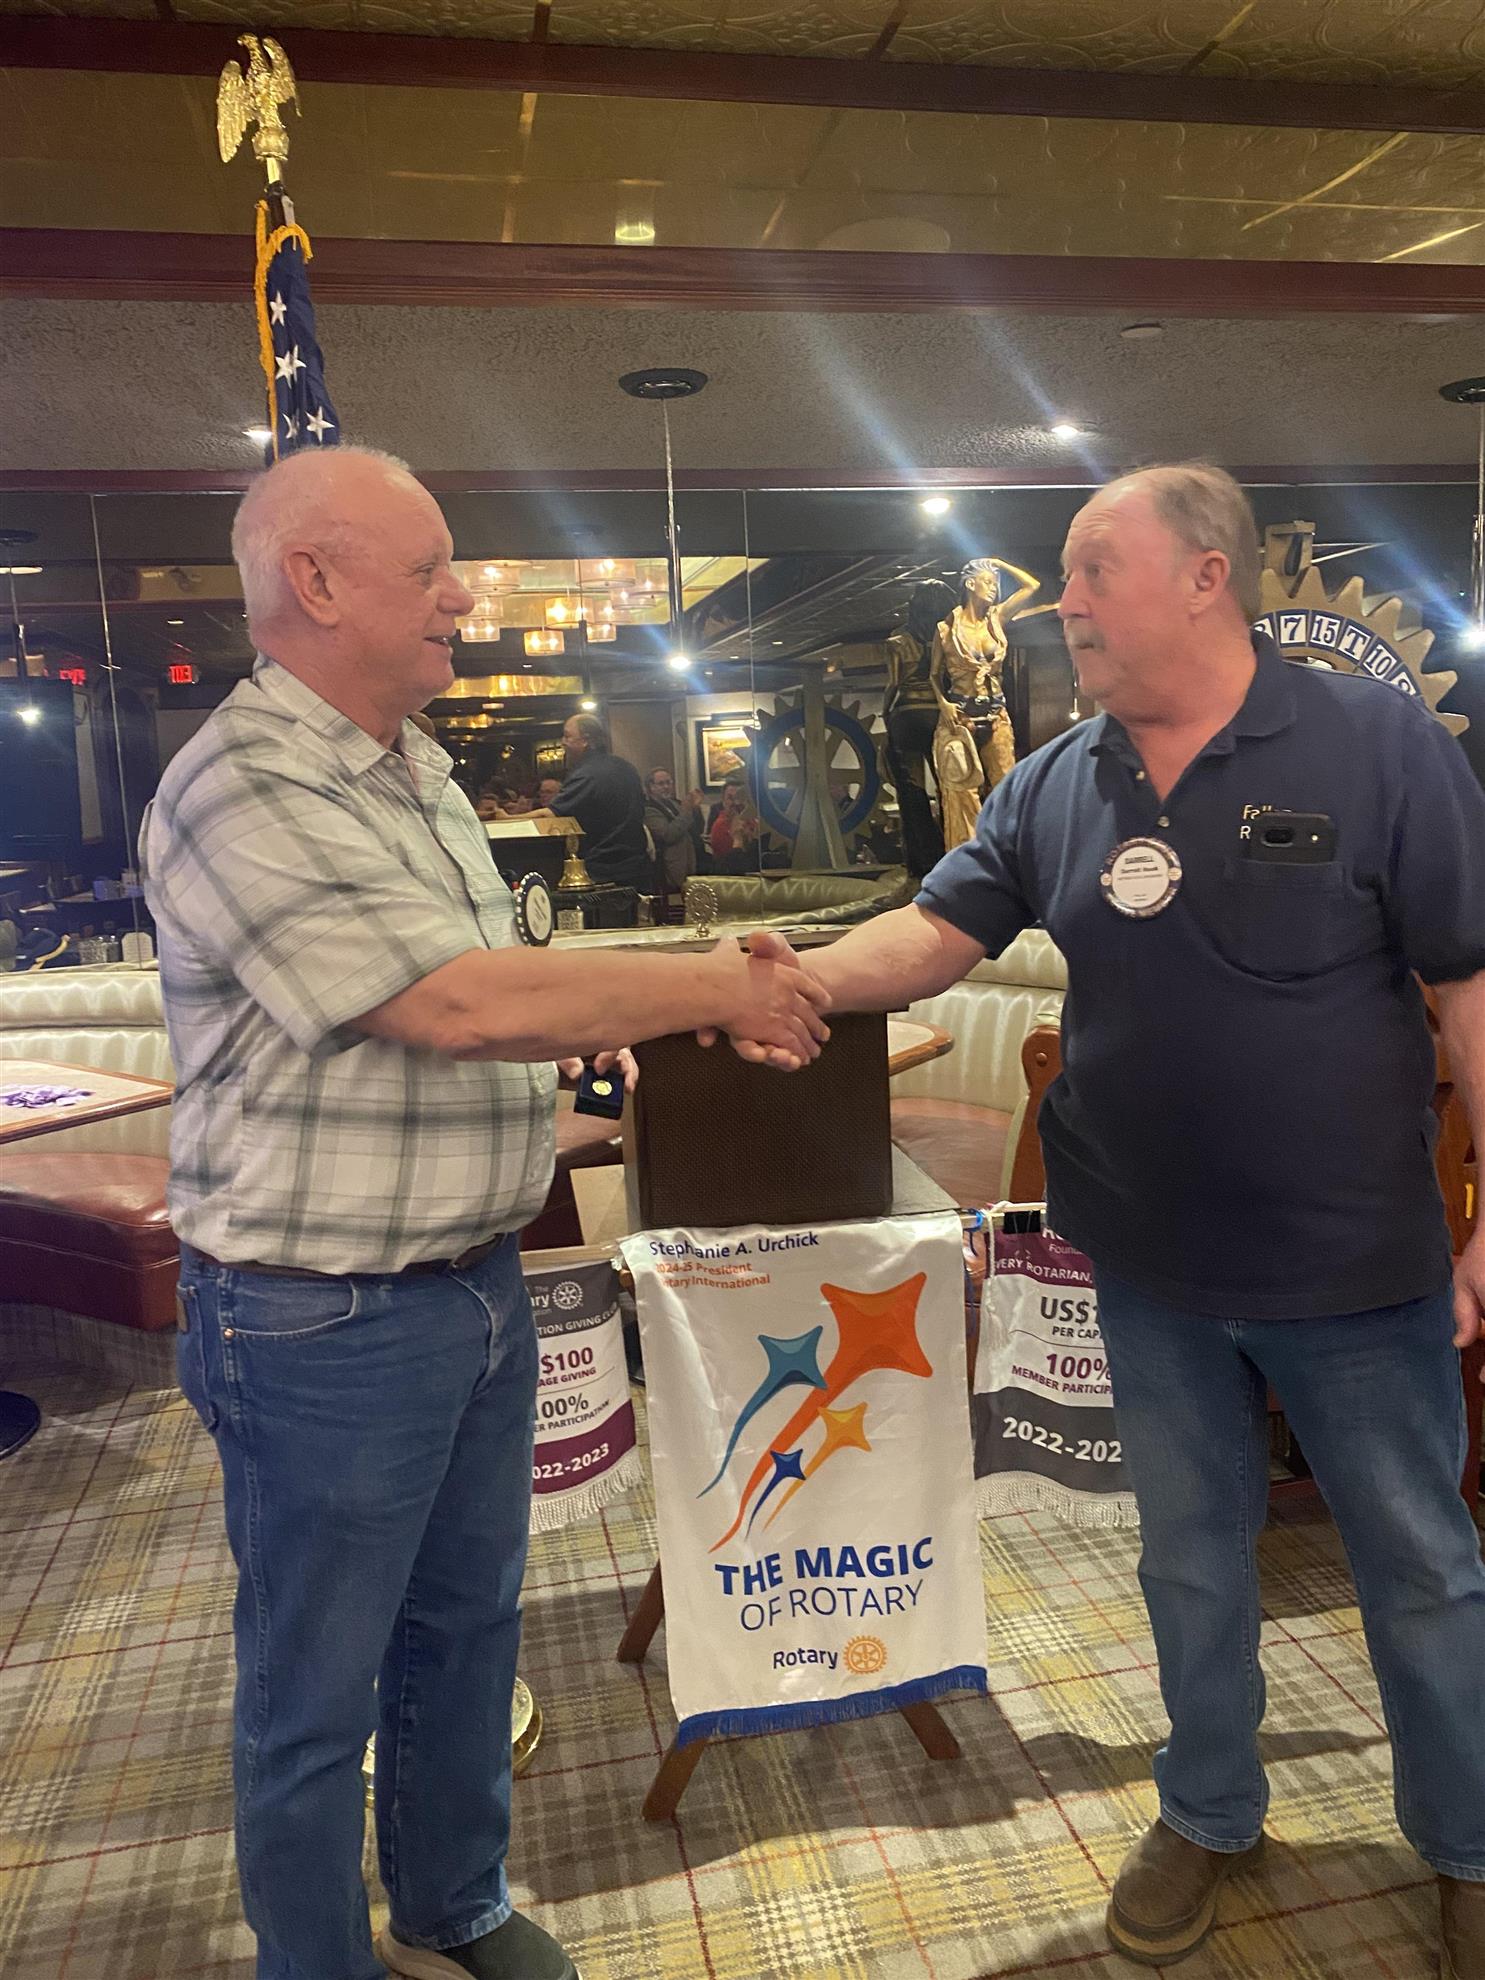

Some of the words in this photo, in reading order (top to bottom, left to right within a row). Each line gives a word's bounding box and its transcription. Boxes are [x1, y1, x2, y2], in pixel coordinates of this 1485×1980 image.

[1283, 617, 1301, 641] 7
[1312, 616, 1338, 645] 15
[1365, 646, 1393, 678] 10
[649, 1239, 731, 1259] Stephanie
[735, 1241, 752, 1254] A.
[758, 1231, 819, 1253] Urchick
[696, 1262, 752, 1275] President
[691, 1274, 771, 1289] International
[565, 1314, 601, 1330] GIVING
[1052, 1326, 1074, 1338] PER
[541, 1347, 593, 1375] $100
[1046, 1353, 1112, 1380] 100%
[560, 1366, 597, 1383] GIVING
[1012, 1365, 1059, 1390] MEMBER
[714, 1552, 783, 1596] THE
[795, 1536, 934, 1579] MAGIC
[740, 1596, 783, 1631] OF
[789, 1578, 924, 1617] ROTARY
[772, 1646, 838, 1670] Rotary
